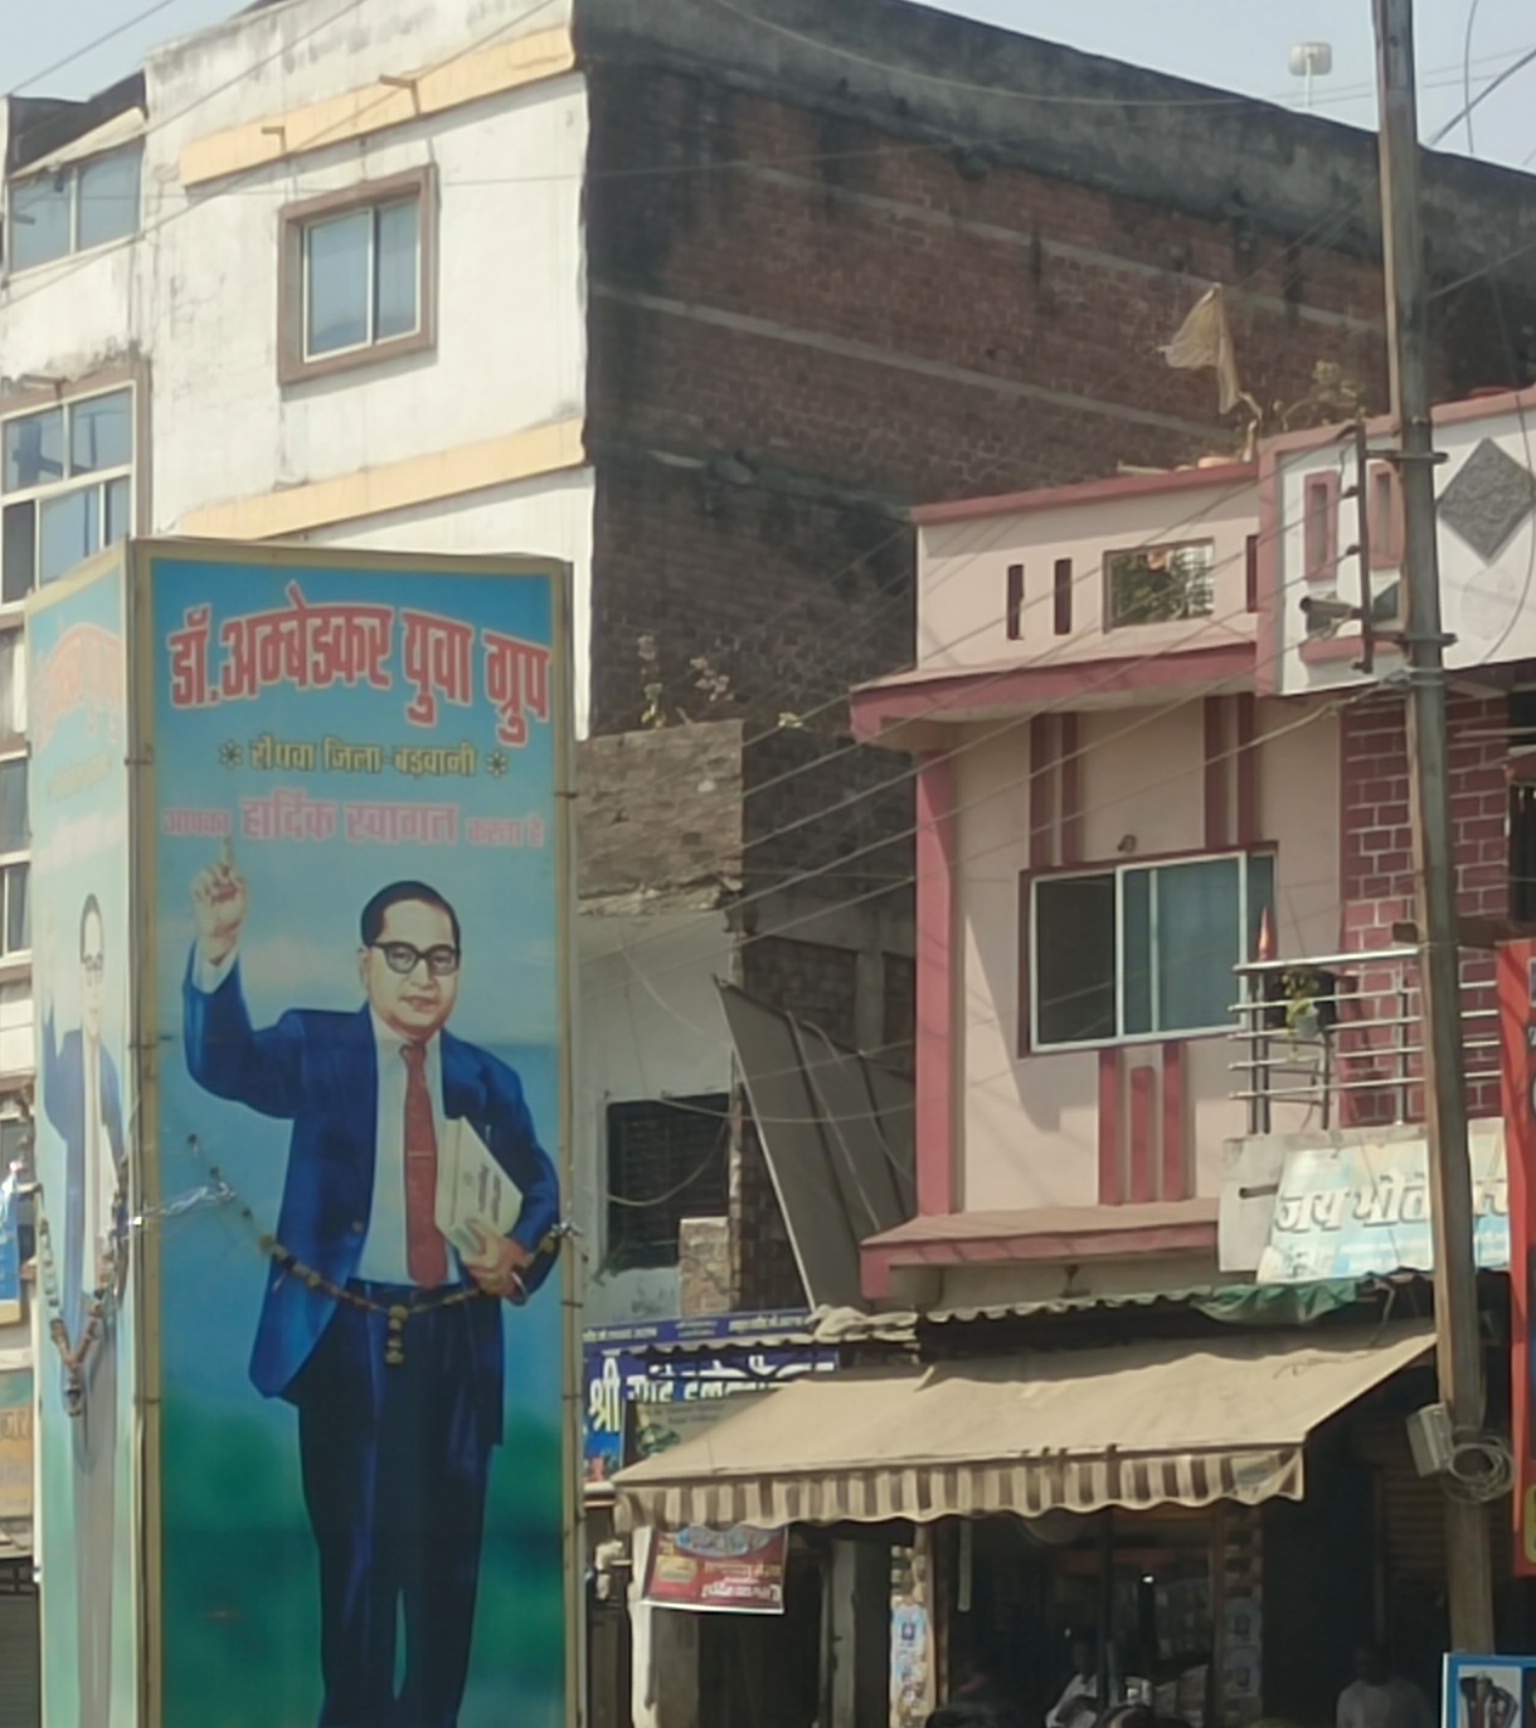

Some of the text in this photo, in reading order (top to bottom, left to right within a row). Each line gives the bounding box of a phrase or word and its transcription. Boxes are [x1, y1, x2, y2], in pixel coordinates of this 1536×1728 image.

[400, 607, 473, 726] युवा
[482, 628, 552, 747] ग्रुप
[239, 787, 336, 843] हार्दिक
[345, 803, 458, 844] स्वागत
